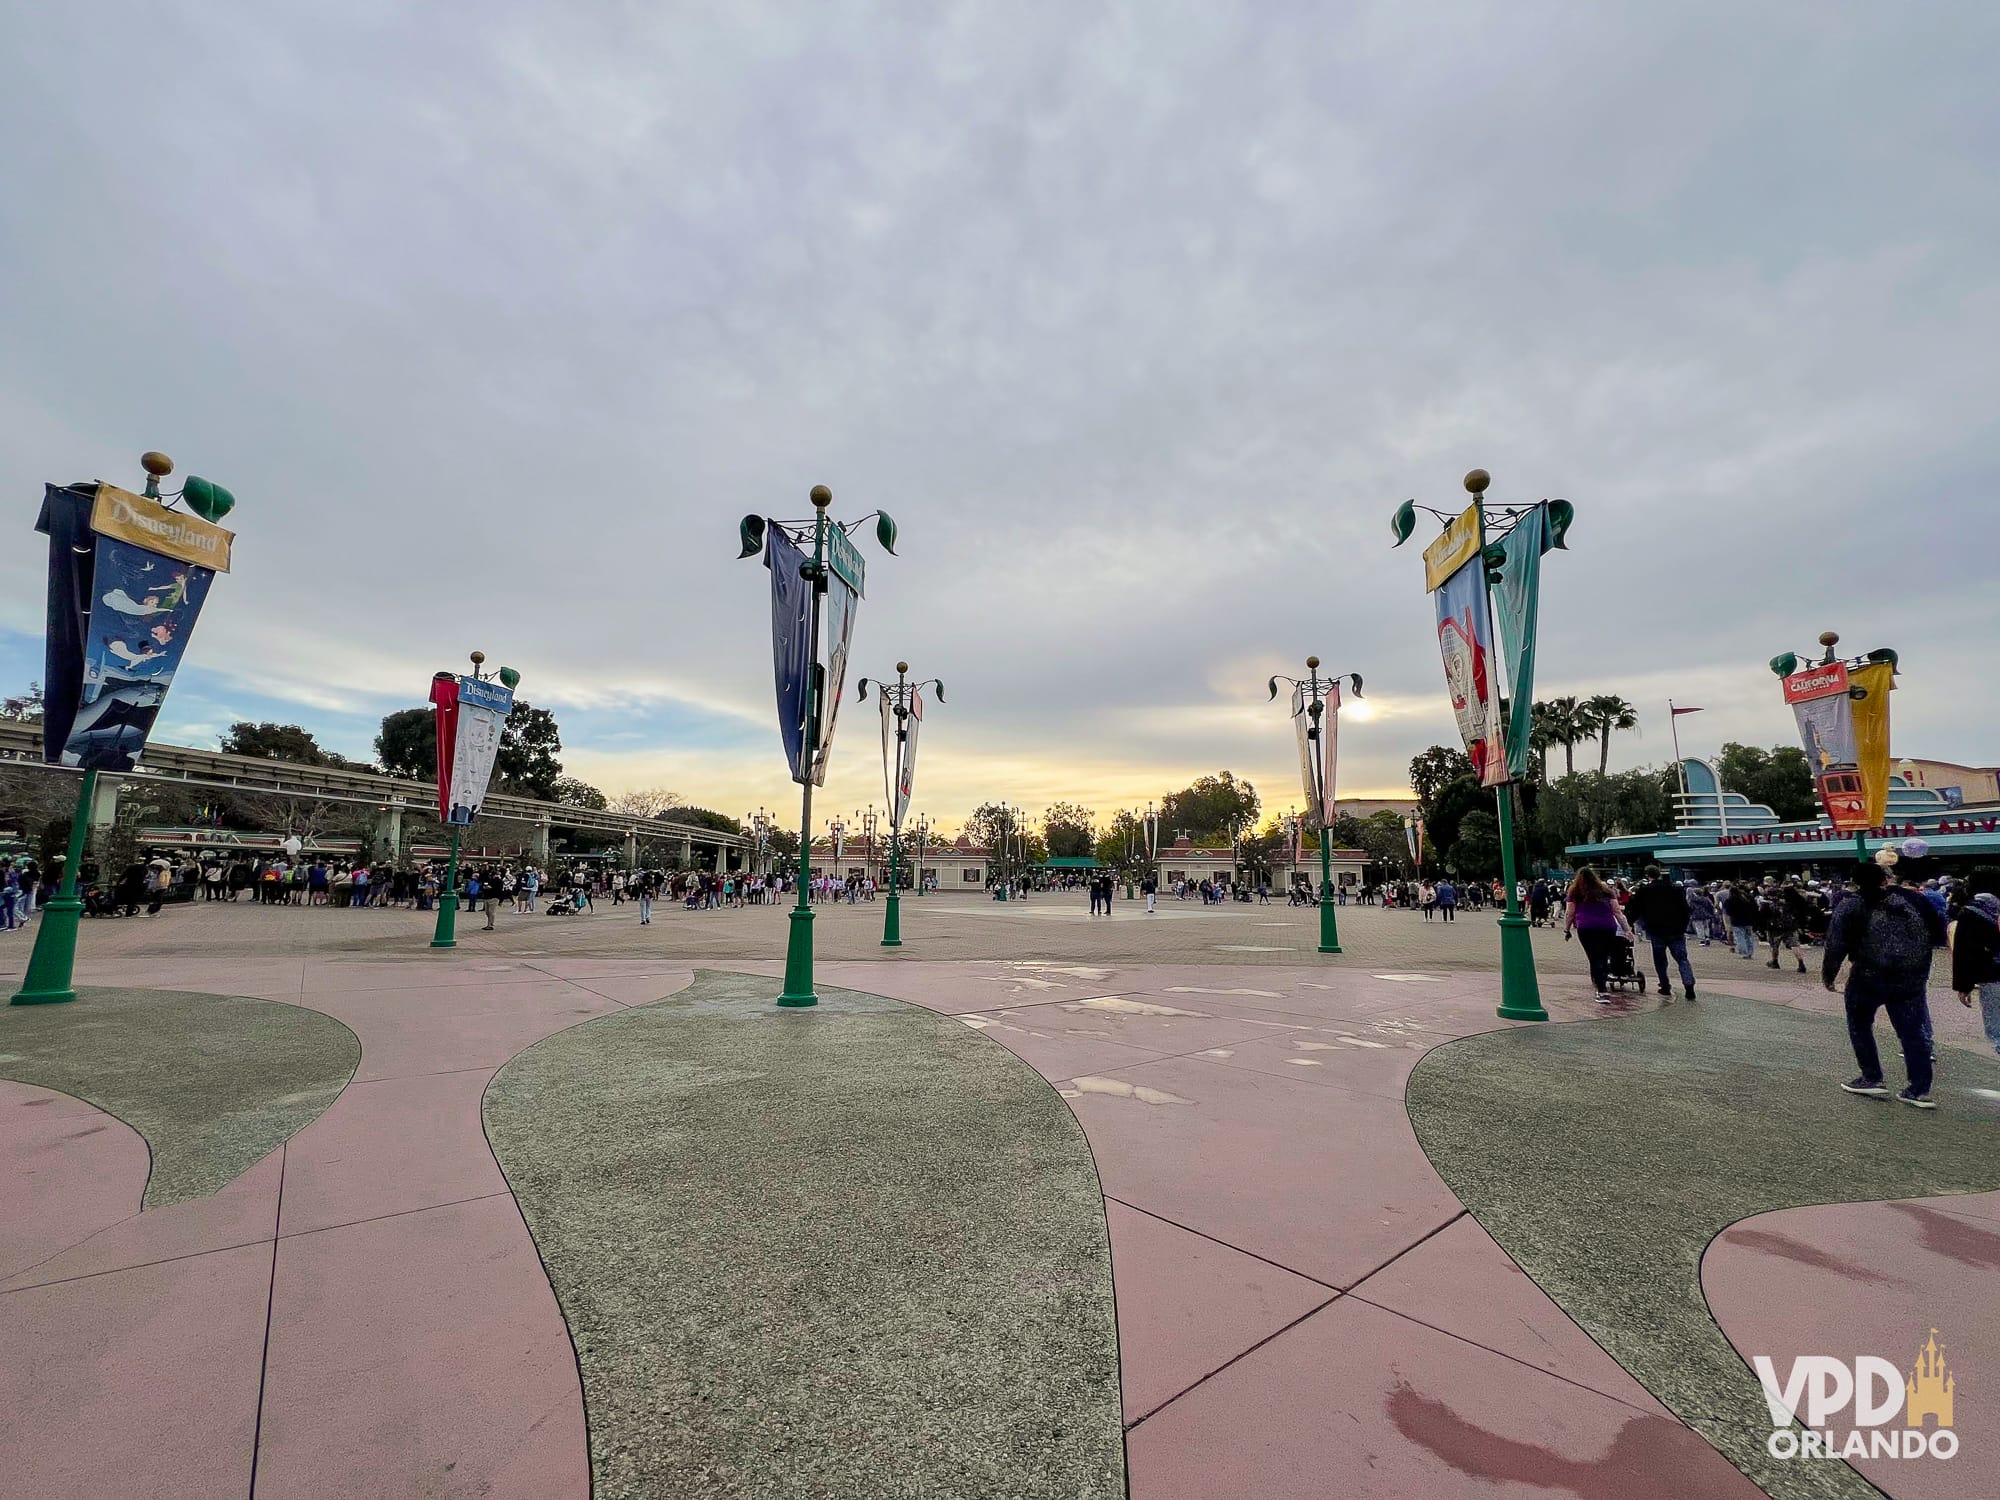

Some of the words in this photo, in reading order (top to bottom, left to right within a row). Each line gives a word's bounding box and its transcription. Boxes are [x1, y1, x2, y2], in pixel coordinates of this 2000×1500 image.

[109, 496, 218, 553] Disneyland
[464, 681, 508, 704] Disneyland
[1780, 822, 1918, 842] CALIFONIA
